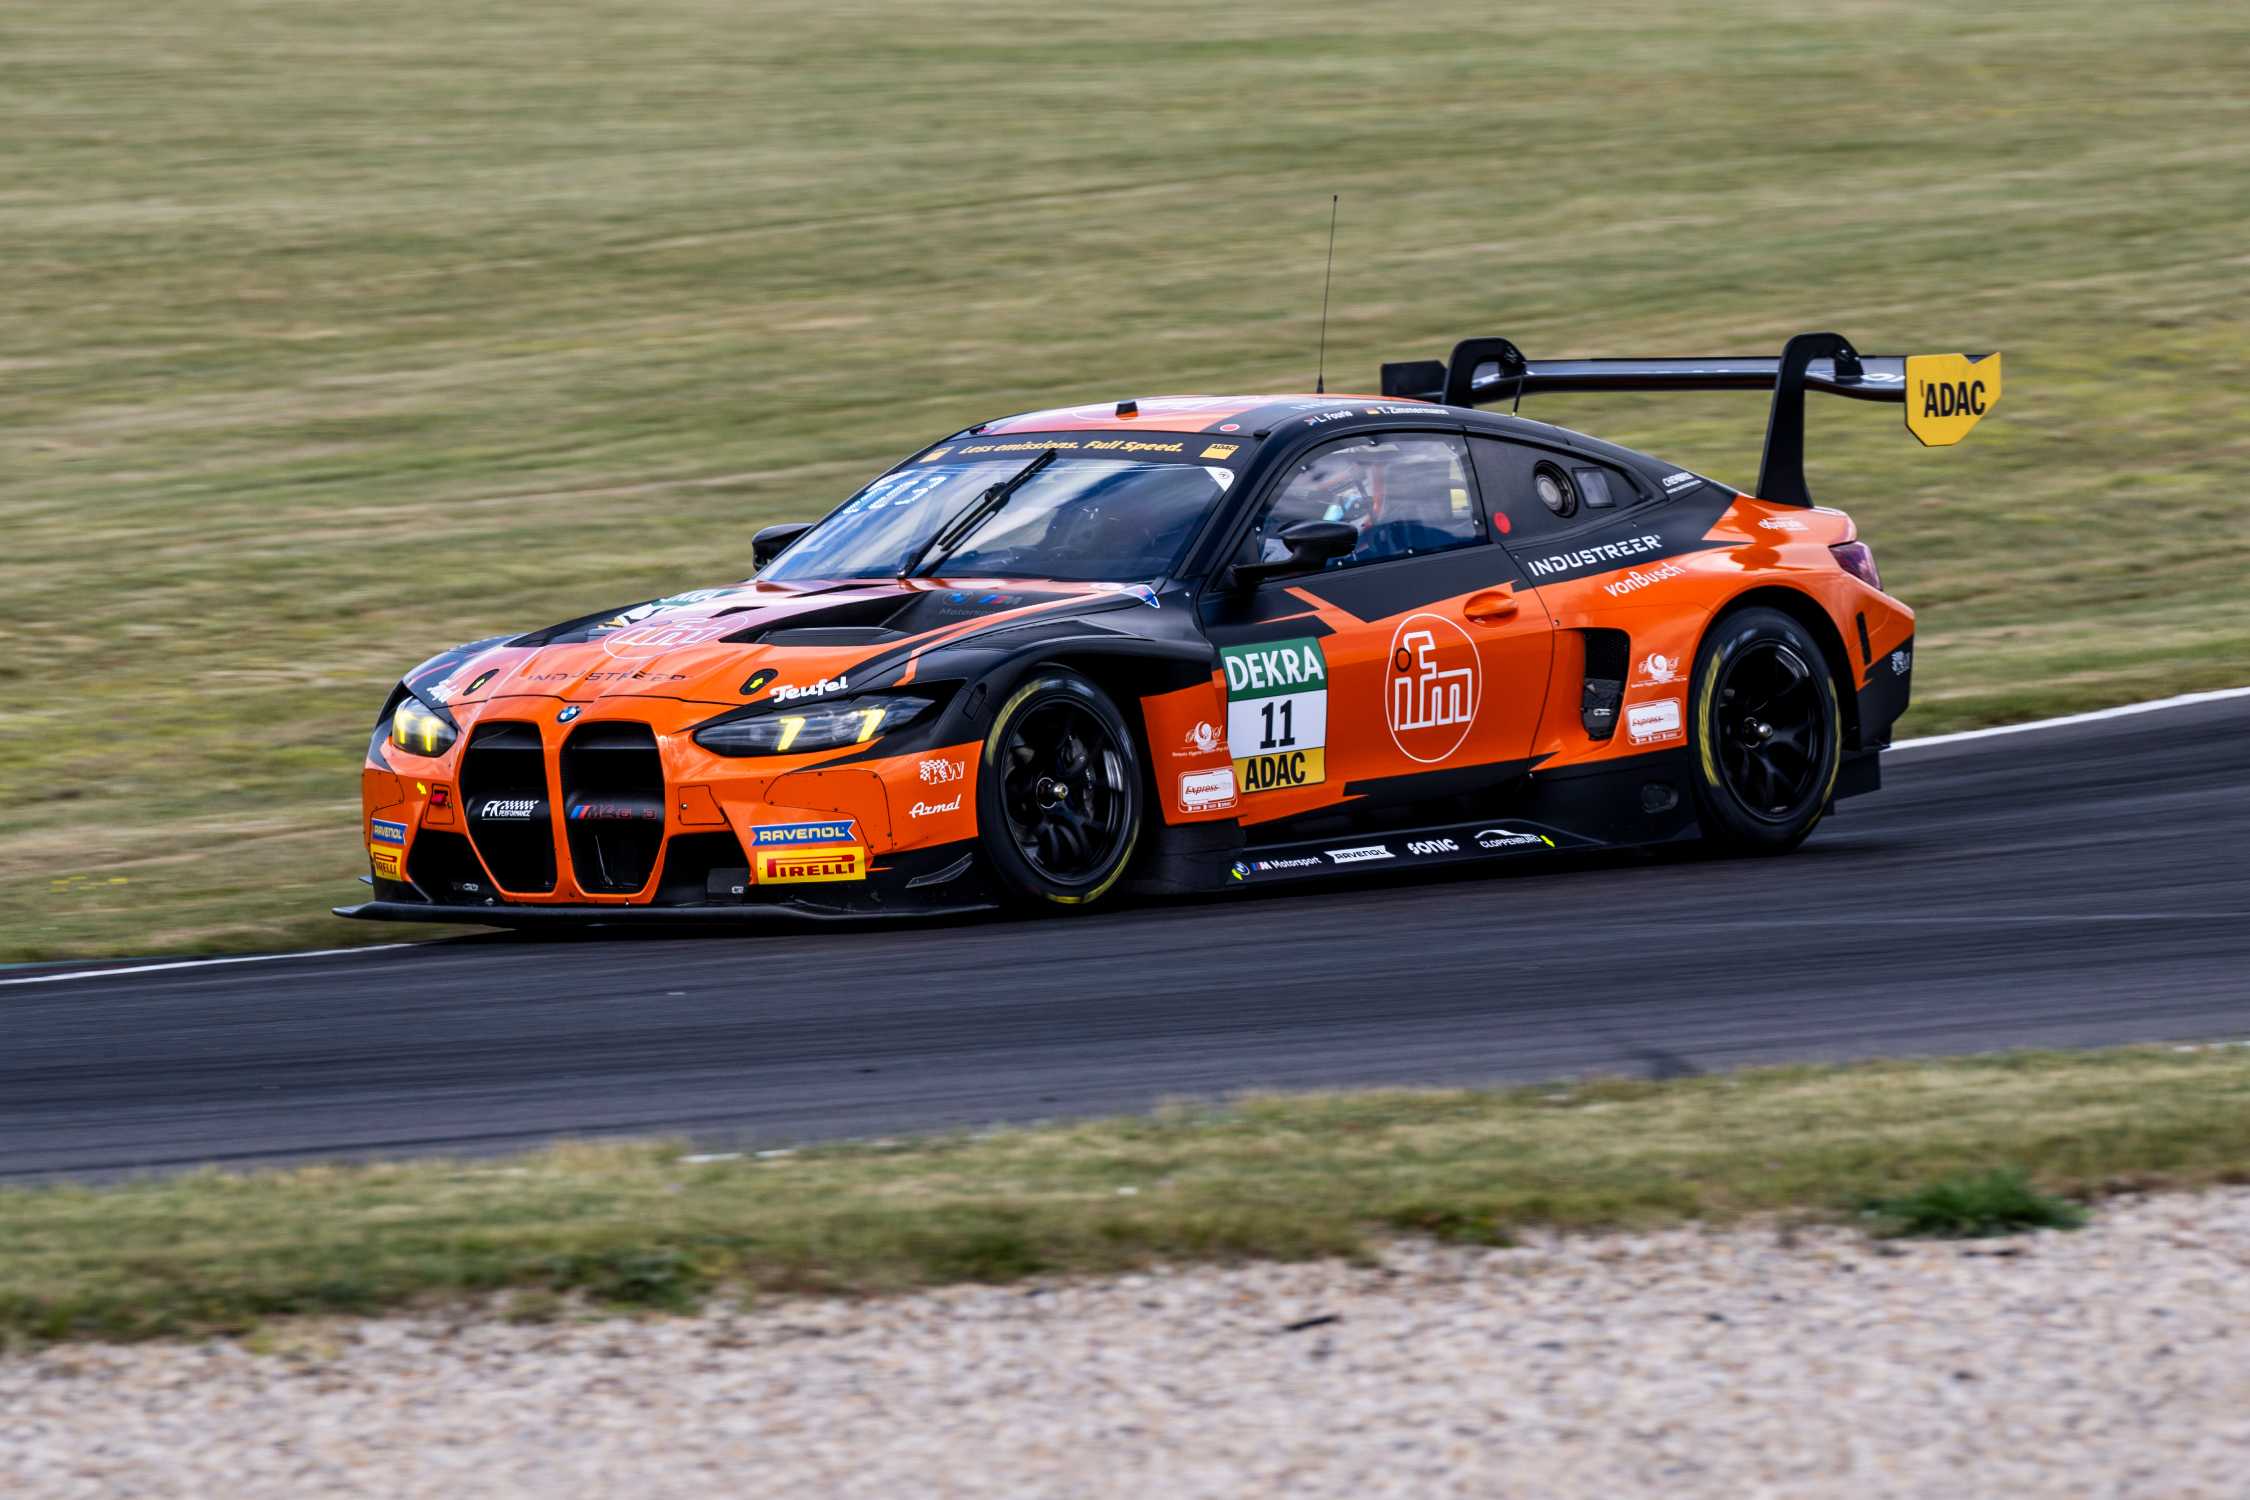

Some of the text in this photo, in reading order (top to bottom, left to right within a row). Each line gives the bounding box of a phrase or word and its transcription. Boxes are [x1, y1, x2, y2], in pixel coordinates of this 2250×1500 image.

[1924, 380, 1986, 417] ADAC
[959, 440, 1183, 455] Less emissions. Full Speed.
[1604, 562, 1687, 598] vonBusch
[1224, 645, 1325, 692] DEKRA
[769, 676, 849, 703] Teufel
[1394, 630, 1473, 732] ifm
[1260, 700, 1296, 749] 11
[928, 761, 965, 785] KW
[1245, 751, 1306, 791] ADAC
[482, 800, 504, 817] FK
[499, 809, 532, 817] PERFORMANCE
[908, 794, 962, 818] Armal
[374, 824, 403, 839] RAVENOL
[759, 826, 846, 843] RAVENOL
[766, 853, 855, 879] PIRELLI
[1270, 856, 1322, 869] Motorsport
[1334, 847, 1386, 862] RAVENOL
